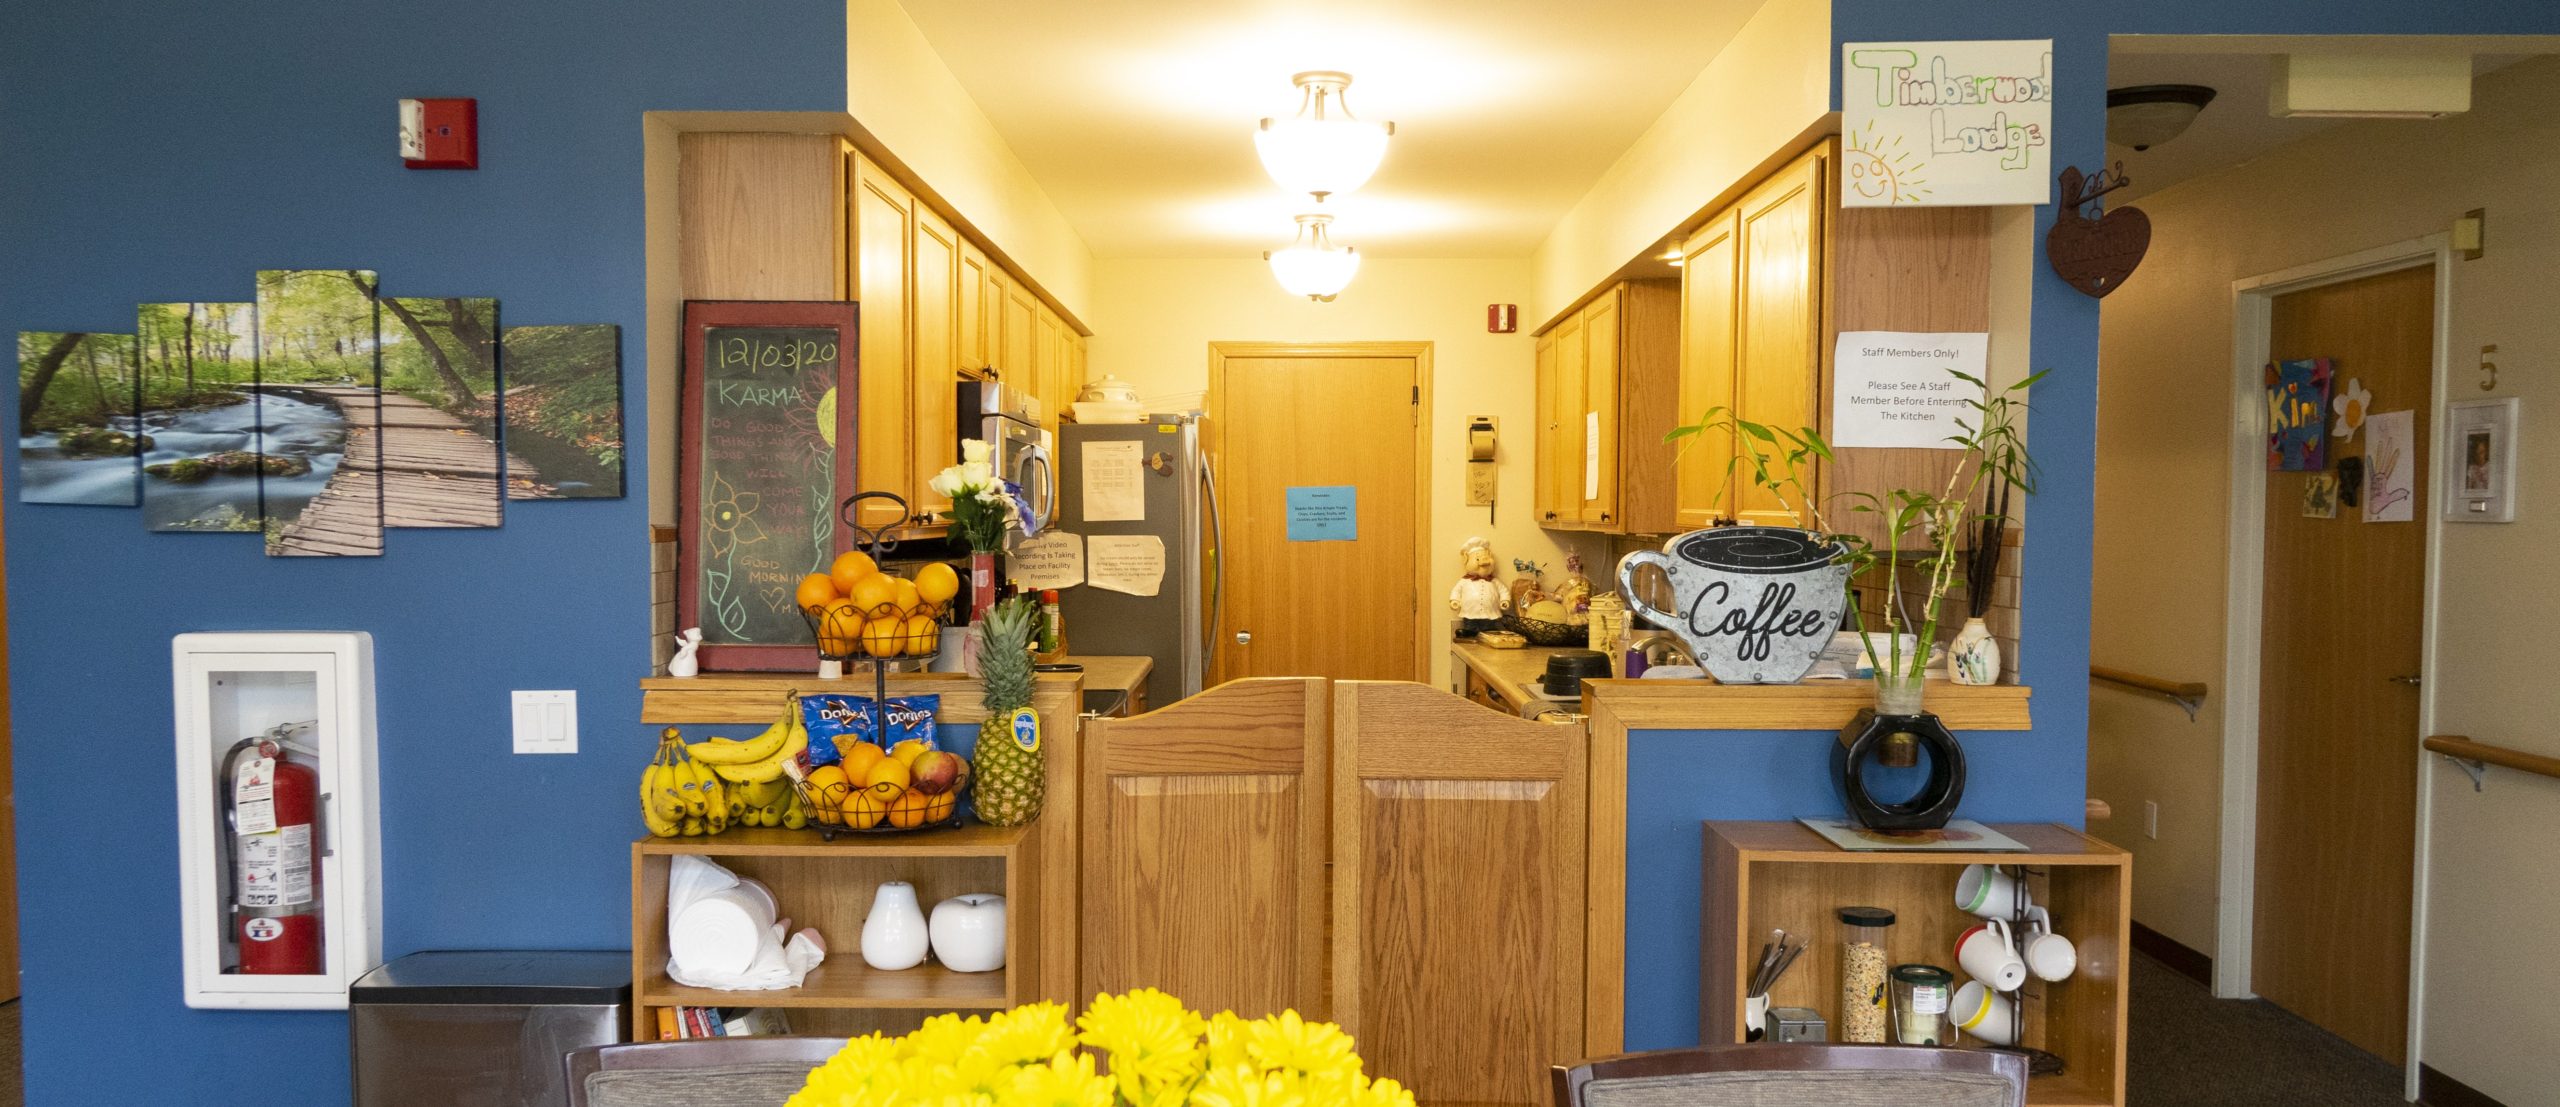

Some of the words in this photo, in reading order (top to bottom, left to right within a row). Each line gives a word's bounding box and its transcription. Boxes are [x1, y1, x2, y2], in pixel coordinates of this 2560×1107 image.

[1852, 50, 2052, 107] Timberwood
[1930, 108, 2046, 170] Lodge
[720, 338, 837, 374] 12/03/20
[1862, 348, 1885, 357] Staff
[1886, 348, 1932, 358] Members
[1933, 349, 1960, 360] Only!
[2479, 344, 2499, 391] 5
[1868, 381, 1898, 391] Please
[1900, 382, 1918, 391] See
[1919, 382, 1927, 391] A
[1929, 382, 1951, 391] Staff
[1850, 396, 1891, 405] Member
[1893, 397, 1925, 405] Before
[1927, 398, 1967, 409] Entering
[1881, 411, 1898, 420] The
[1900, 412, 1935, 421] Kitchen
[741, 556, 780, 569] GOOD
[1055, 552, 1076, 560] Taking
[749, 571, 806, 585] MORNIN
[1688, 581, 1825, 661] Coffee
